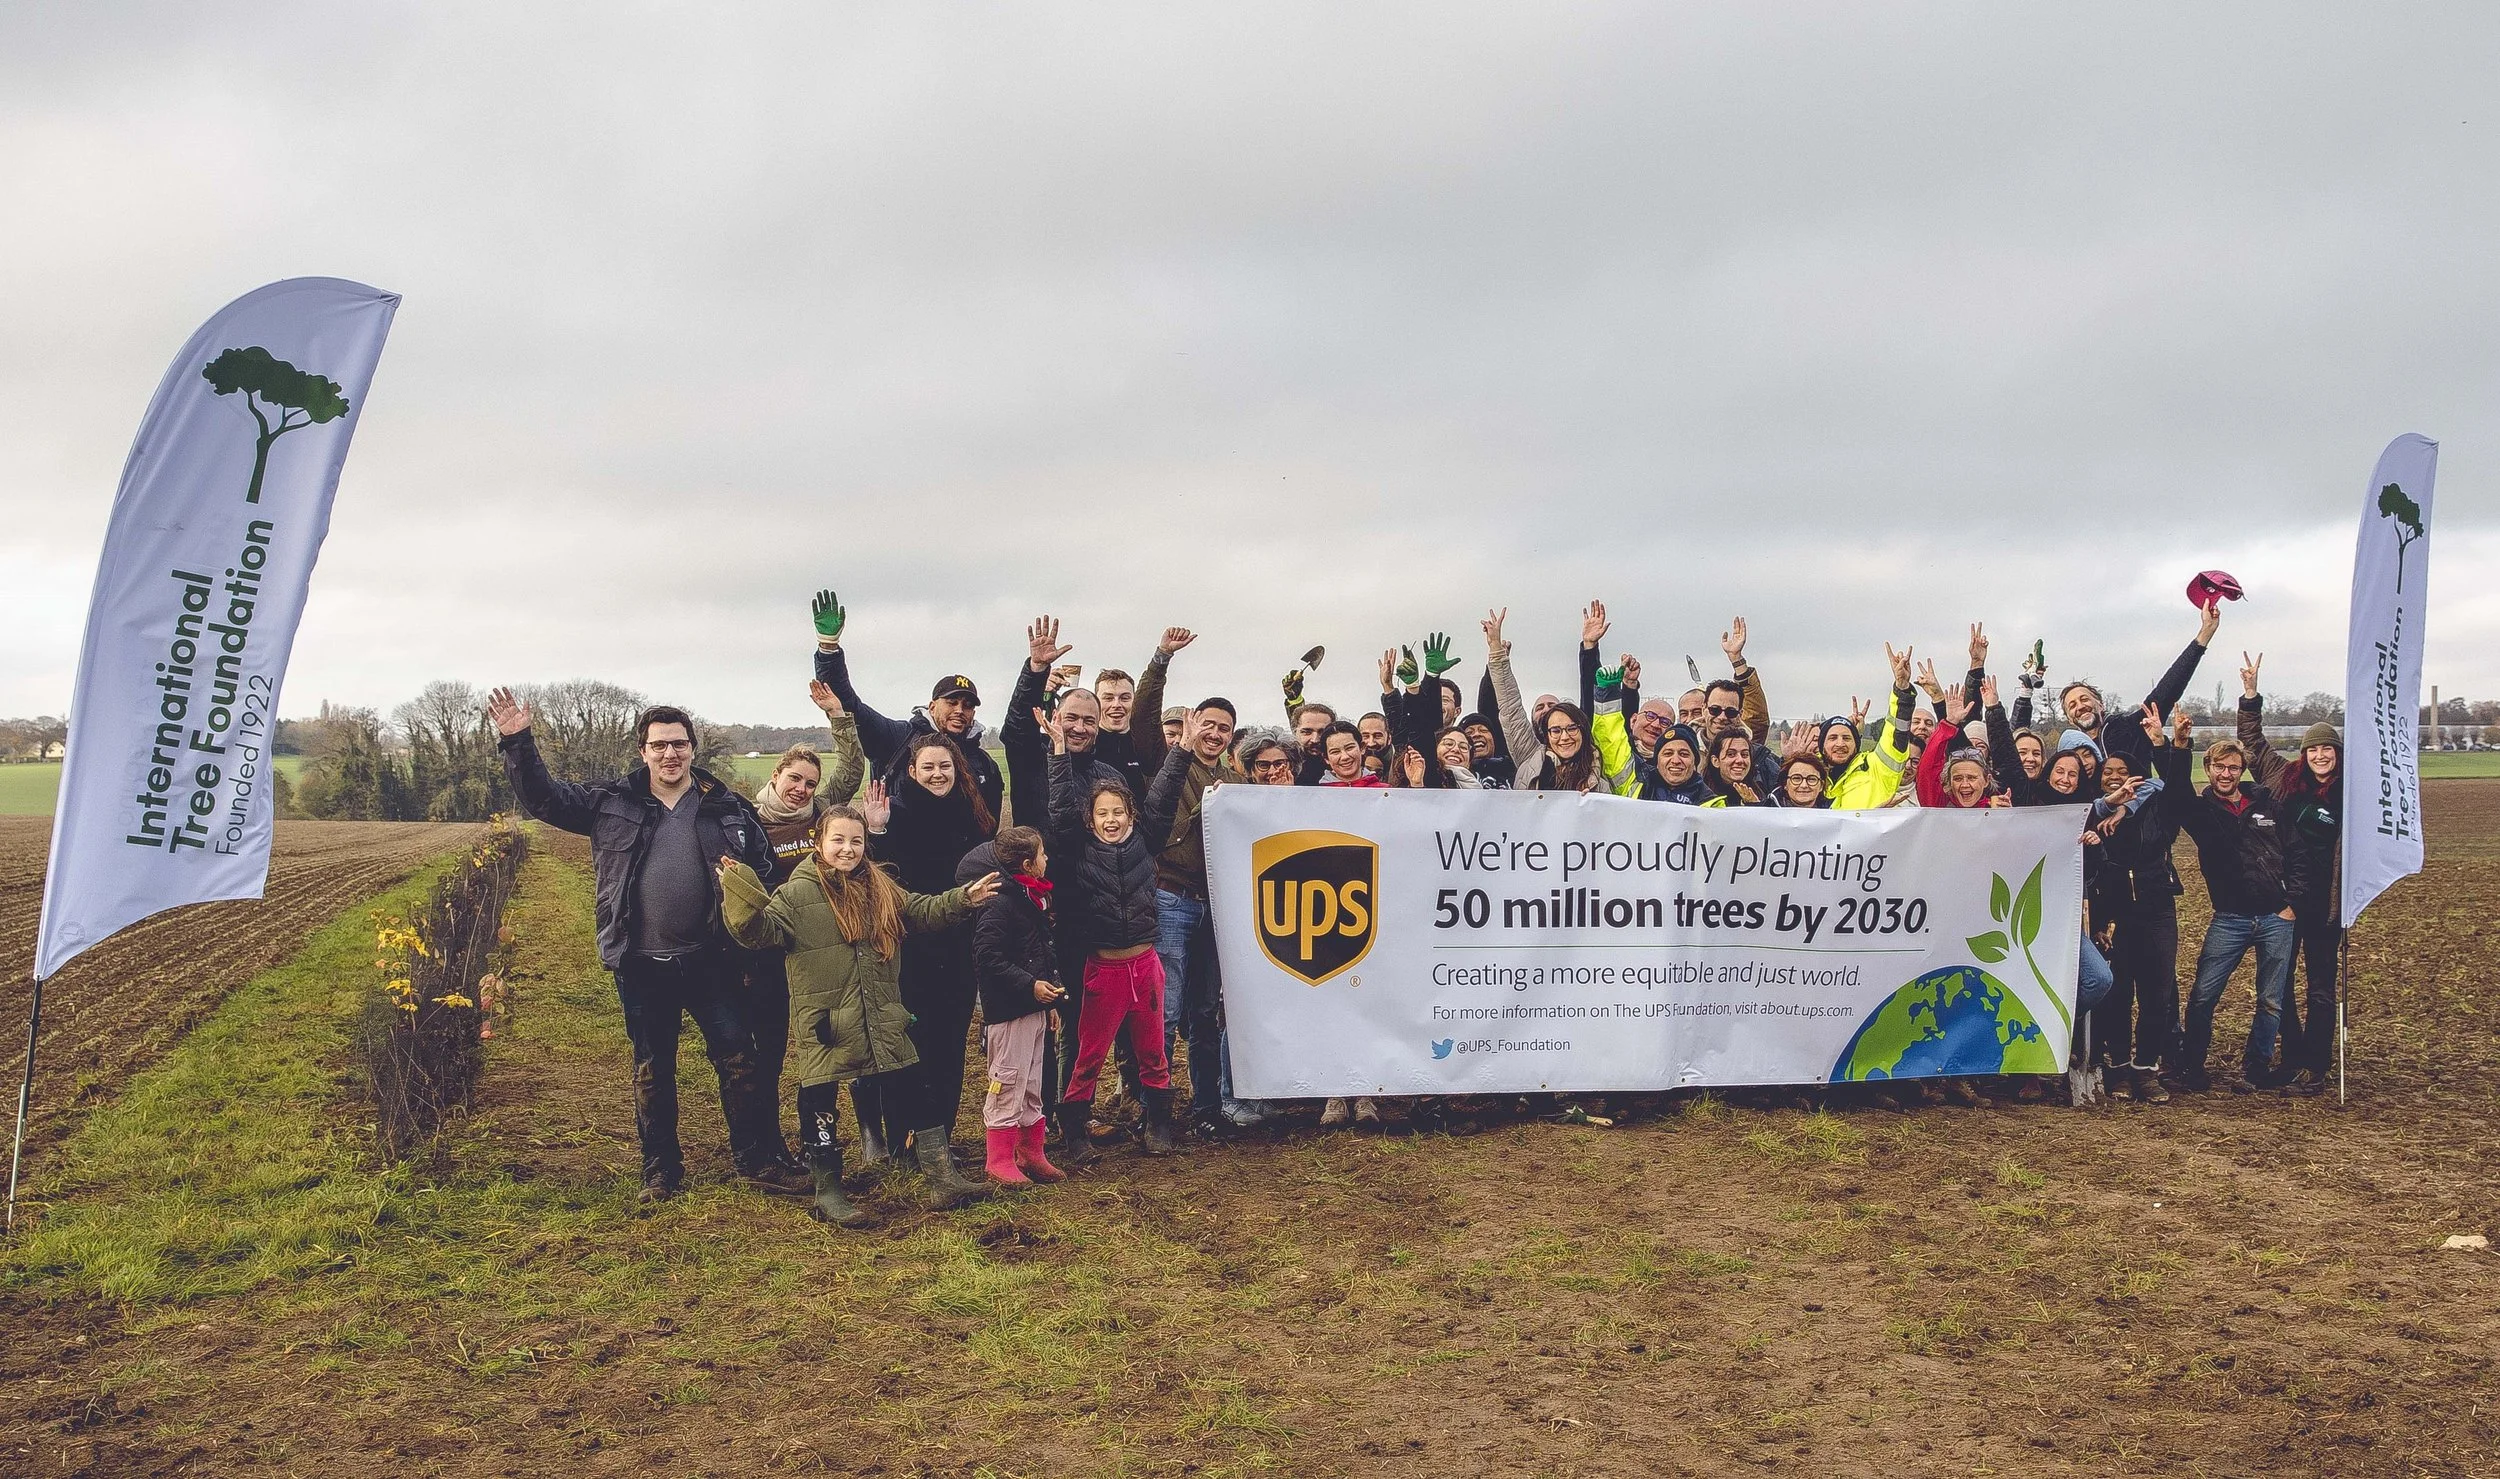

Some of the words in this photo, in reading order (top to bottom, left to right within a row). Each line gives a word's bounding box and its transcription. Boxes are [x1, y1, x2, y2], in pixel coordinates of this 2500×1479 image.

[189, 519, 274, 755] Foundation
[126, 569, 213, 847] International
[2385, 607, 2403, 771] Foundation
[215, 742, 260, 855] Founded
[239, 674, 273, 736] 1922
[2375, 641, 2393, 835] International
[2398, 716, 2411, 759] 1922
[169, 762, 221, 854] Tree
[1676, 793, 1693, 804] UP
[1563, 831, 1724, 884] proudly
[1730, 837, 1887, 892] planting
[1262, 879, 1369, 961] ups
[1433, 888, 1491, 928] 50
[1503, 887, 1663, 928] million
[1674, 891, 1767, 929] trees
[1774, 893, 1828, 944] by
[1833, 897, 1930, 934] 2030.
[1432, 963, 1528, 990] Creating
[1532, 970, 1544, 986] a
[1551, 968, 1615, 986] more
[1718, 962, 1752, 983] and
[1754, 963, 1797, 988] just
[1801, 965, 1862, 987] world.
[1433, 1006, 1456, 1019] For
[1460, 1007, 1498, 1018] more
[1502, 1004, 1586, 1018] information
[1590, 1006, 1609, 1017] on
[1613, 1003, 1641, 1017] The
[1645, 1003, 1671, 1017] UPS
[1735, 1002, 1758, 1015] visit
[1760, 1002, 1854, 1019] about.ups.com.
[1456, 1039, 1571, 1054] @UPS_Foundation
